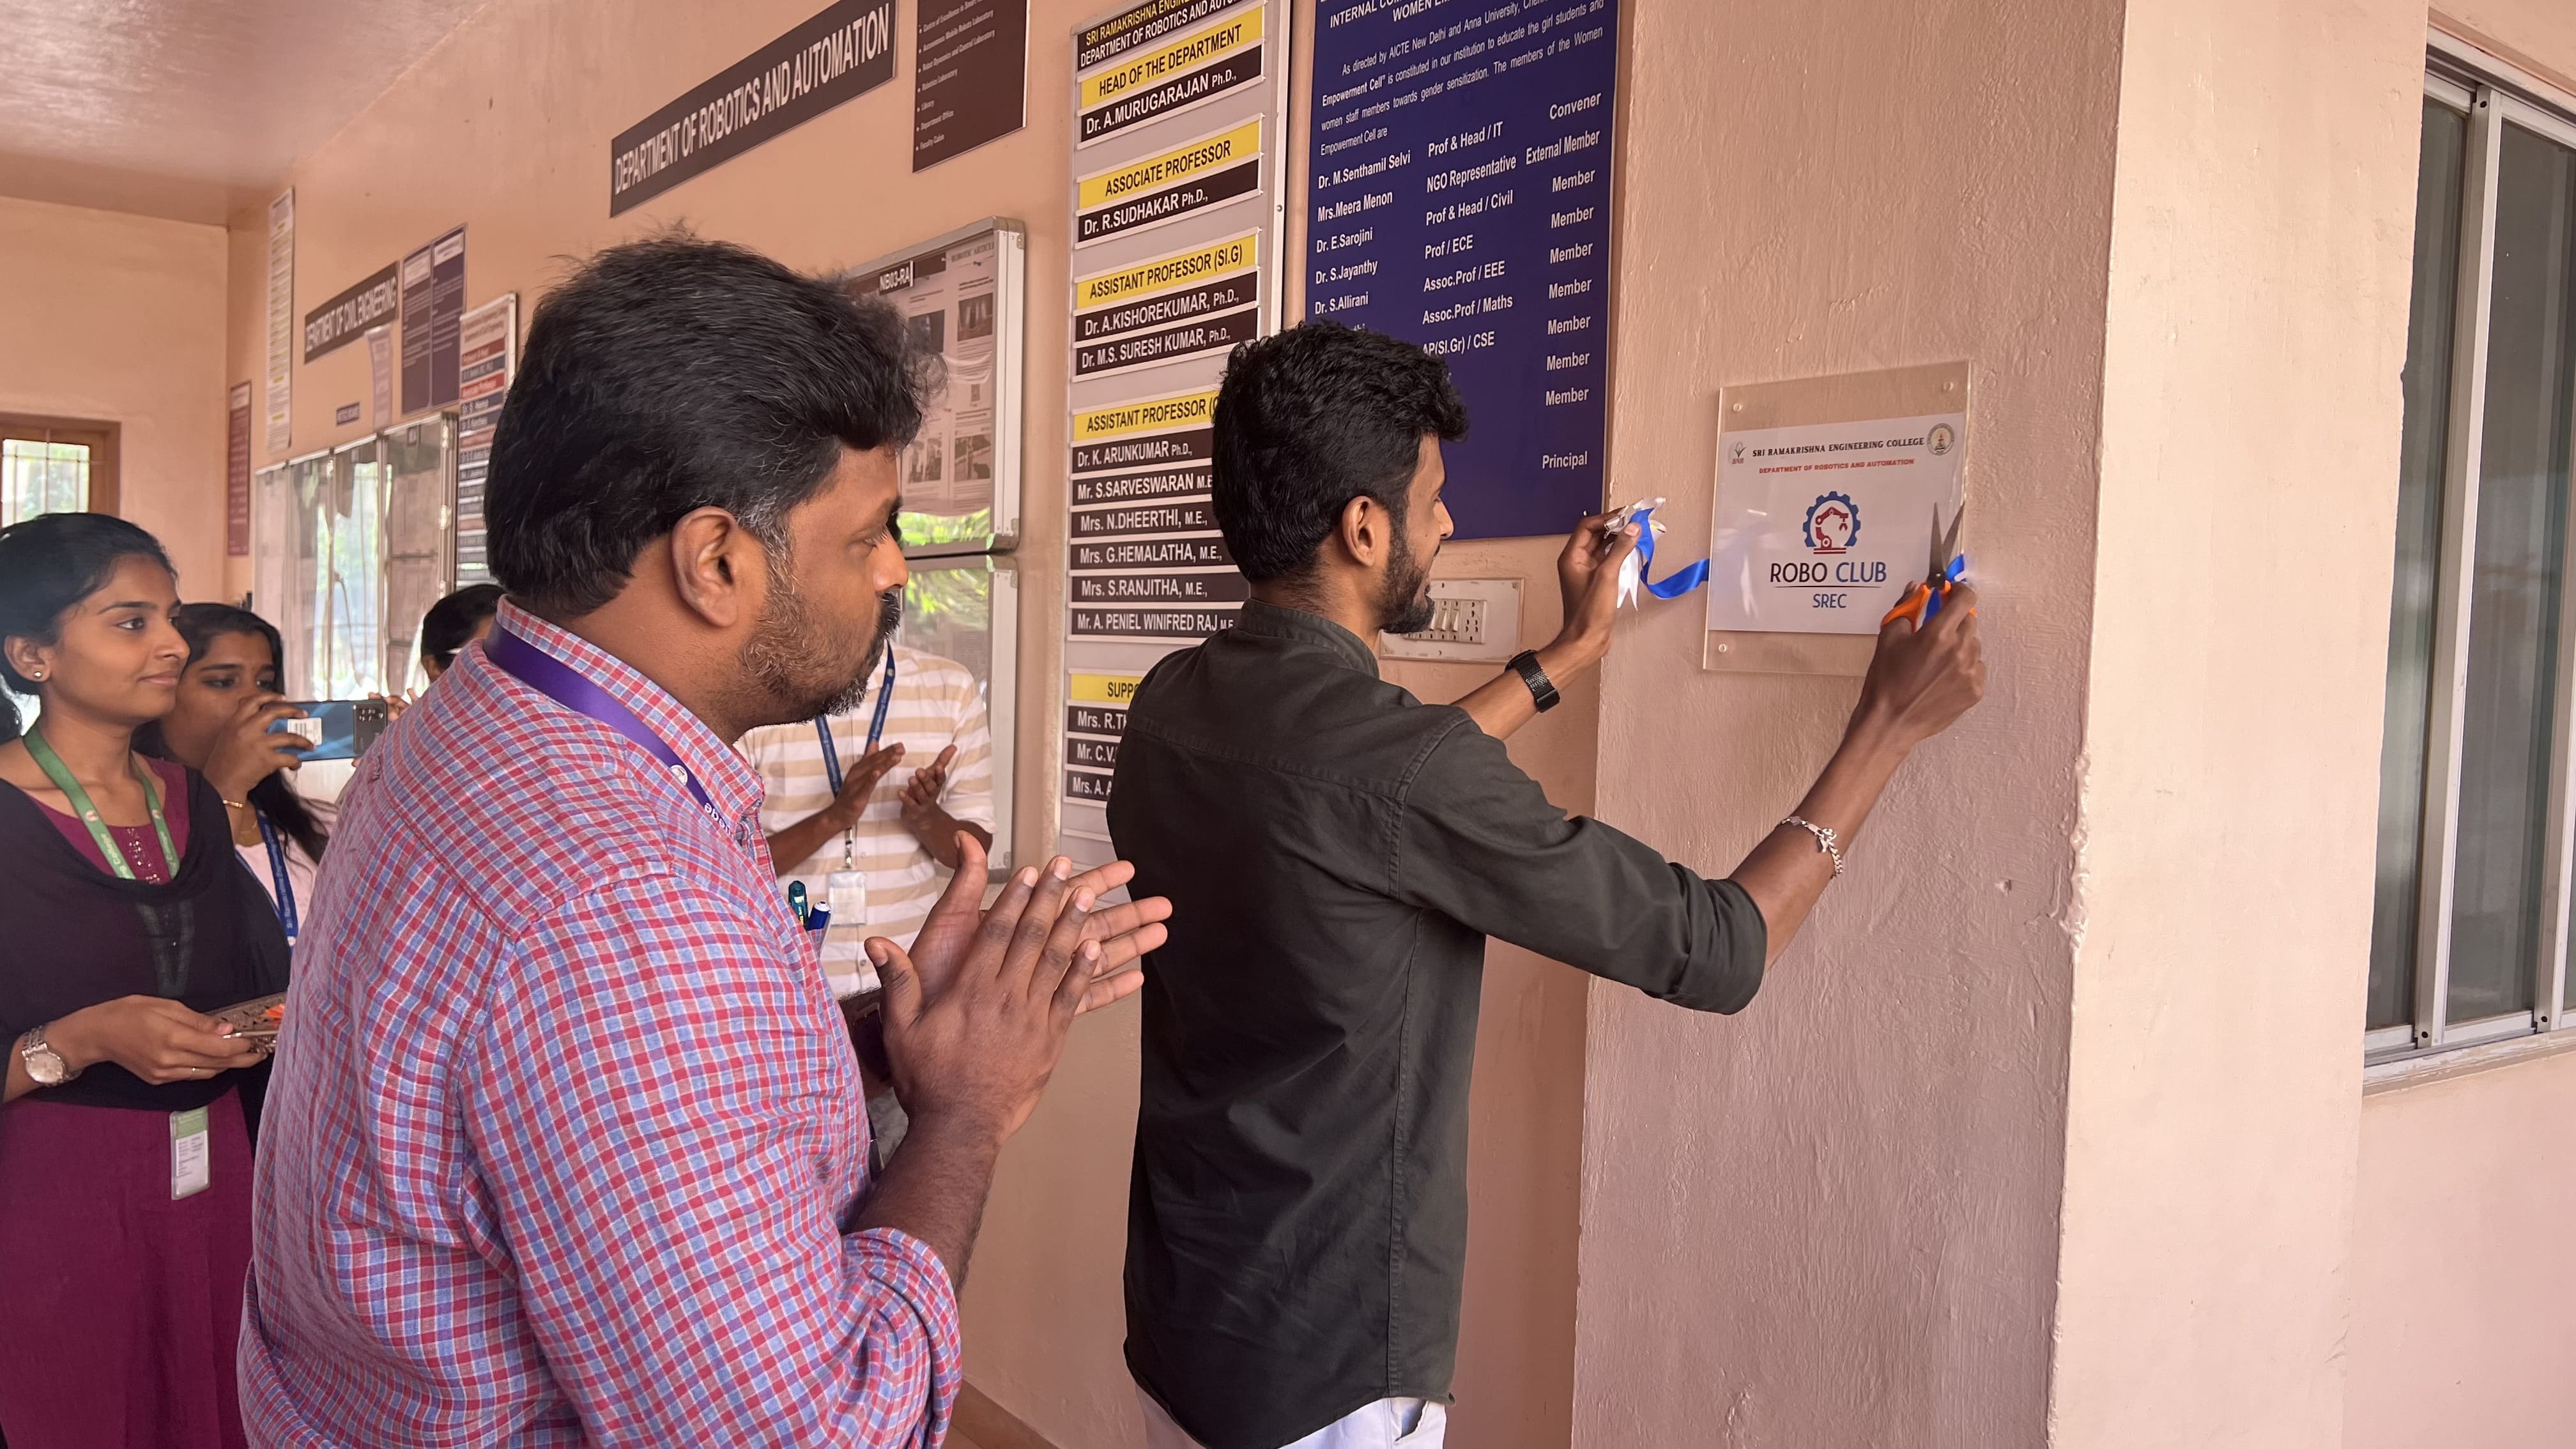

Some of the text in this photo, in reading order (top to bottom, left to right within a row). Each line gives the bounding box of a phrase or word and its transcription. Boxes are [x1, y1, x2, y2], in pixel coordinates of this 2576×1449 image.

[1086, 7, 1157, 46] SRI RAMAKRISHNA
[1330, 0, 1377, 28] INTERNAL
[1392, 0, 1432, 22] WOMEN
[1081, 33, 1131, 66] DEPARTMENT
[1133, 28, 1144, 45] OF
[1146, 8, 1188, 39] ROBOTICS
[1189, 1, 1207, 21] AND
[1342, 63, 1351, 76] As
[1353, 53, 1377, 72] directed
[1379, 50, 1387, 64] by
[1389, 41, 1410, 59] AICTE
[1412, 36, 1427, 51] New
[1429, 26, 1446, 44] Delhi
[1448, 21, 1462, 37] and
[1464, 16, 1482, 31] Anna
[1484, 3, 1521, 24] University,
[1100, 24, 1241, 96] HEAD OF THE DEPARTMENT
[1322, 82, 1367, 107] Empowerment
[1388, 72, 1393, 84] is
[1395, 59, 1429, 81] constituted
[1431, 57, 1438, 69] in
[1440, 53, 1452, 66] our
[1453, 42, 1485, 61] institution
[1488, 38, 1494, 49] to
[1497, 26, 1524, 46] educate
[1528, 21, 1539, 35] the
[1542, 14, 1553, 33] girl
[1556, 4, 1586, 25] students
[1590, 0, 1604, 13] and
[1321, 26, 1603, 131] women staff members towards gender sensitization. The members of the Women
[615, 3, 889, 195] DEPARTMENT OF ROBOTICS AND AUTOMATION
[1087, 69, 1237, 134] Dr. A.MURUGARAJAN Ph.D.,
[1318, 92, 1602, 189] Dr. M.Senthamil Selvi Prof Head IT Convener
[1321, 127, 1388, 156] Empowerment Cell are
[1105, 140, 1230, 197] ASSOCIATE PROFESSOR
[1317, 130, 1600, 222] Mrs.Meera Menon NGO Representative External Member
[1084, 188, 1208, 235] Dr. R.SUDHAKAR Ph.D.,
[1316, 169, 1595, 253] Dr. E.Sarojini Prof Head Civil Member
[1315, 206, 1594, 284] Dr. S.Jayanthy Prof ECE Member
[1090, 253, 1211, 298] ASSISTANT PROFESSOR
[1315, 242, 1593, 315] Dr. S.Allirani Assoc.Prof EEE Member
[1085, 319, 1100, 335] Dr.
[1102, 292, 1210, 332] A.KISHOREKUMAR,
[1422, 278, 1592, 325] Assoc.Prof Maths Member
[1082, 328, 1206, 369] Dr. M.S. SURESH KUMAR,
[1473, 315, 1591, 349] CSE Member
[1547, 351, 1590, 371] Member
[1545, 387, 1589, 407] Member
[1087, 410, 1140, 432] ASSISTANT
[1142, 399, 1206, 424] PROFESSOR
[1078, 441, 1169, 467] Dr. K. ARUNKUMAR
[1542, 451, 1588, 470] Principal
[1752, 438, 1924, 457] SRI RAMAKRISHNA ENGINEERING COLLEGE
[1759, 466, 1802, 474] DEPARTMENT
[1814, 463, 1848, 471] ROBOTICS
[1867, 459, 1915, 468] AUTOMATION
[1078, 473, 1194, 500] Mr. S.SARVESWARAN
[1081, 515, 1104, 531] Mrs.
[1107, 509, 1181, 530] N.DHEERTHI,
[1080, 548, 1103, 564] Mrs.
[1106, 543, 1196, 563] G.HEMALATHA,
[1082, 580, 1105, 596] Mrs.
[1108, 579, 1182, 597] S.RANJITHA,
[1770, 561, 1887, 583] ROBO CLUB
[1813, 593, 1847, 609] SREC
[1078, 613, 1092, 629] Mr.
[1093, 614, 1103, 629] A.
[1106, 613, 1141, 630] PENIEL
[1144, 614, 1194, 631] WINIFRED
[1197, 614, 1218, 631] RAJ
[1078, 710, 1101, 728] Mrs.
[1077, 743, 1092, 760] Mr.
[1073, 777, 1092, 793] Mrs.
[1094, 779, 1104, 795] A.
